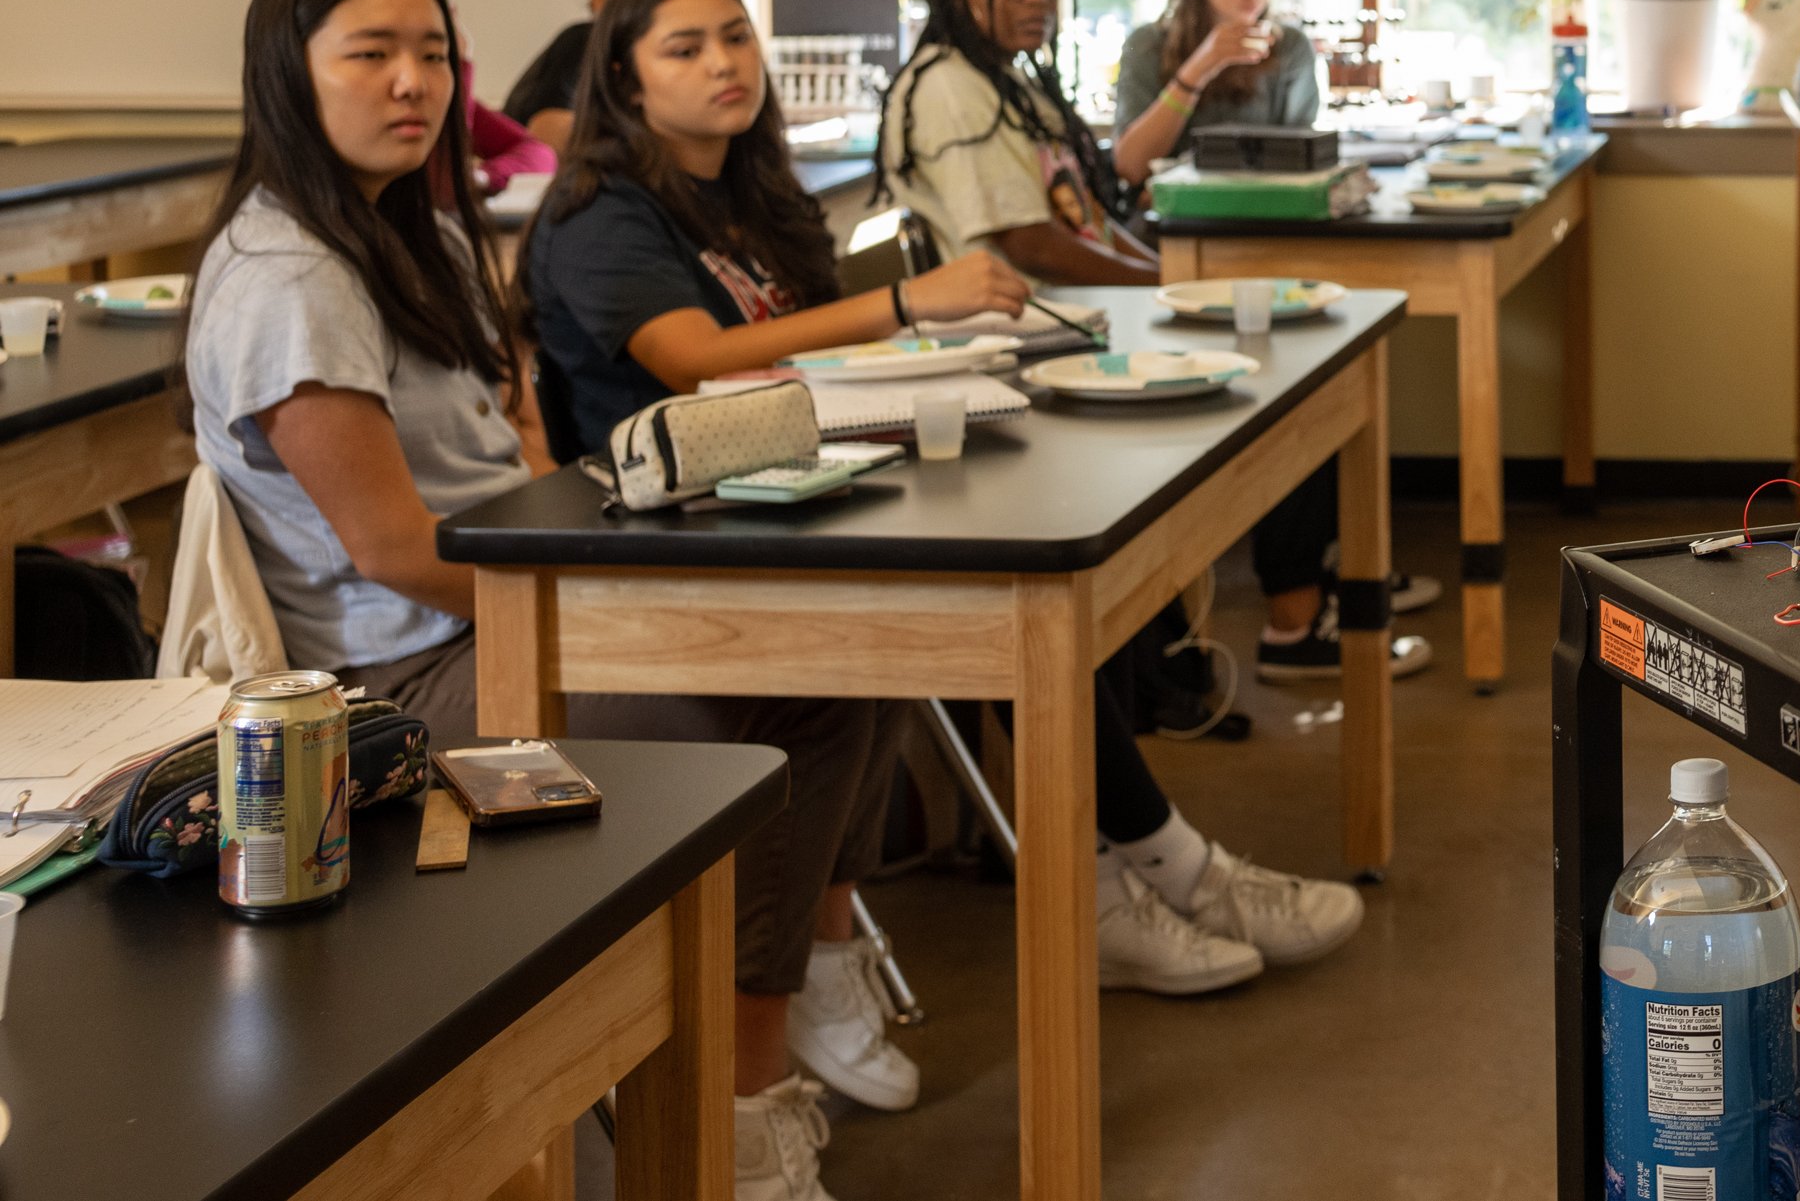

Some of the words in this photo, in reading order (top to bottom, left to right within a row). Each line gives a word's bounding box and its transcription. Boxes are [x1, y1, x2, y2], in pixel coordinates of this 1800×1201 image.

[1648, 1003, 1689, 1016] Nutrition
[1692, 1006, 1720, 1017] Facts
[1648, 1021, 1666, 1030] Serving
[1648, 1038, 1690, 1050] Calories
[1712, 1038, 1721, 1050] 0
